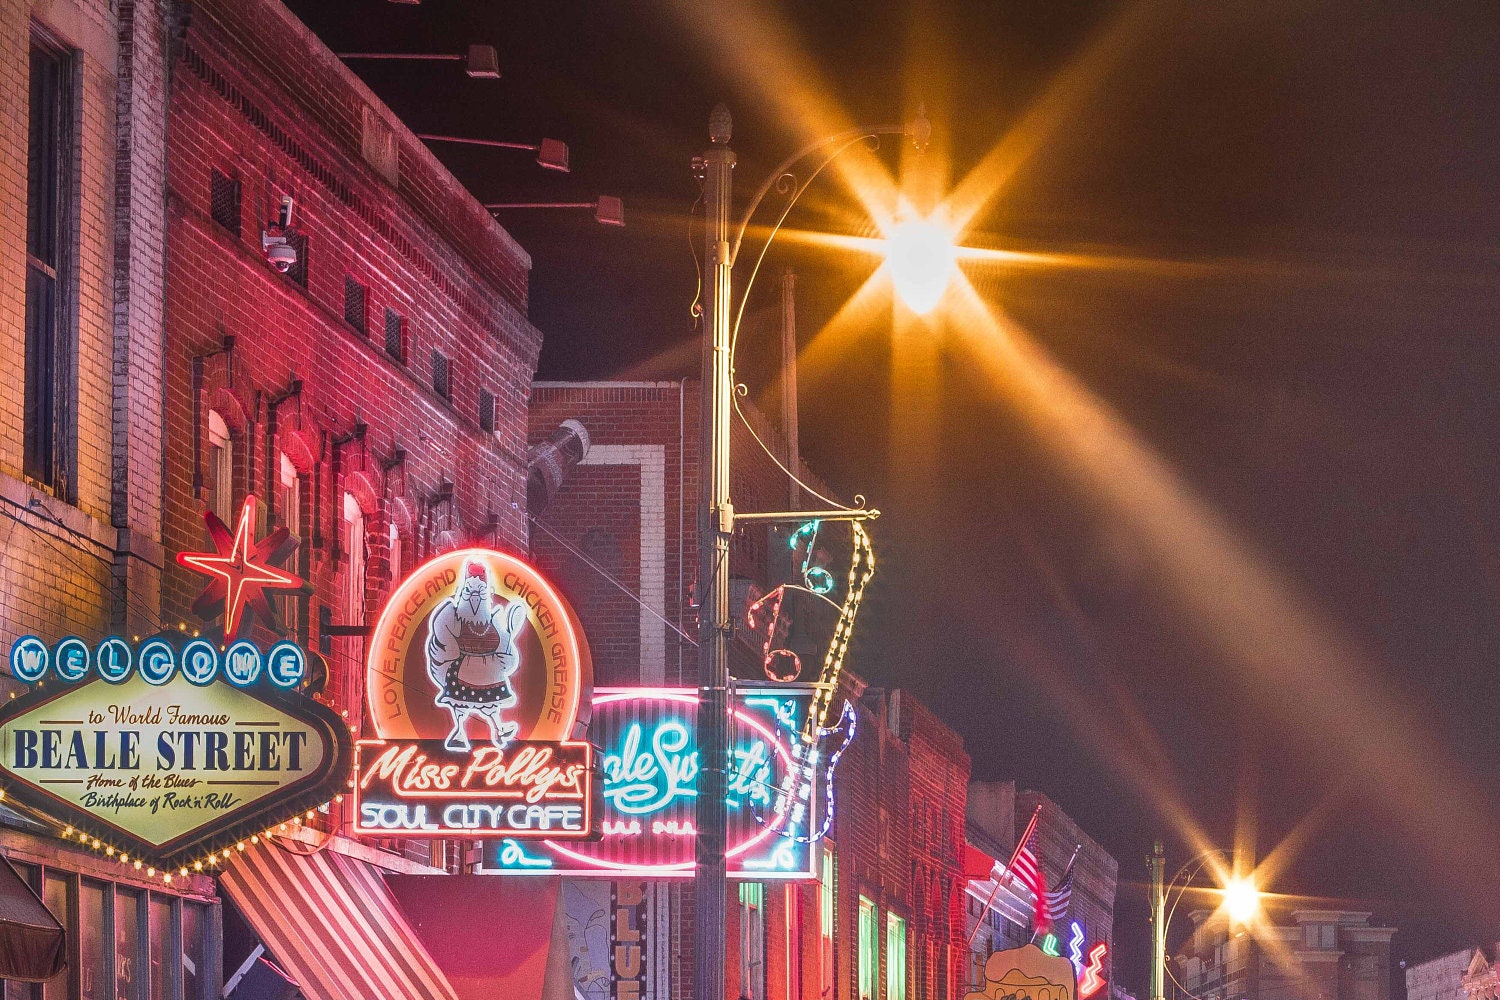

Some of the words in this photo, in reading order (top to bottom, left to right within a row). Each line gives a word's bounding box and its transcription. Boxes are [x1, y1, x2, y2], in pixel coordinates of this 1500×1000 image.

[425, 568, 457, 598] AND
[387, 596, 426, 653] PEACE
[503, 572, 560, 640] CHICKEN
[16, 645, 301, 685] WELCOME
[546, 641, 570, 725] GREASE
[88, 708, 104, 724] to
[108, 704, 162, 726] World
[167, 704, 230, 726] Famous
[13, 729, 140, 770] BEALE
[156, 730, 307, 772] STREET
[361, 744, 460, 790] Miss
[87, 774, 126, 791] Home
[128, 774, 140, 791] of
[142, 775, 161, 789] the
[163, 773, 203, 789] Blues
[79, 791, 148, 814] Birthplace
[149, 792, 161, 810] of
[360, 803, 438, 830] SOUL
[444, 804, 503, 829] CITY
[508, 804, 582, 830] CAFE
